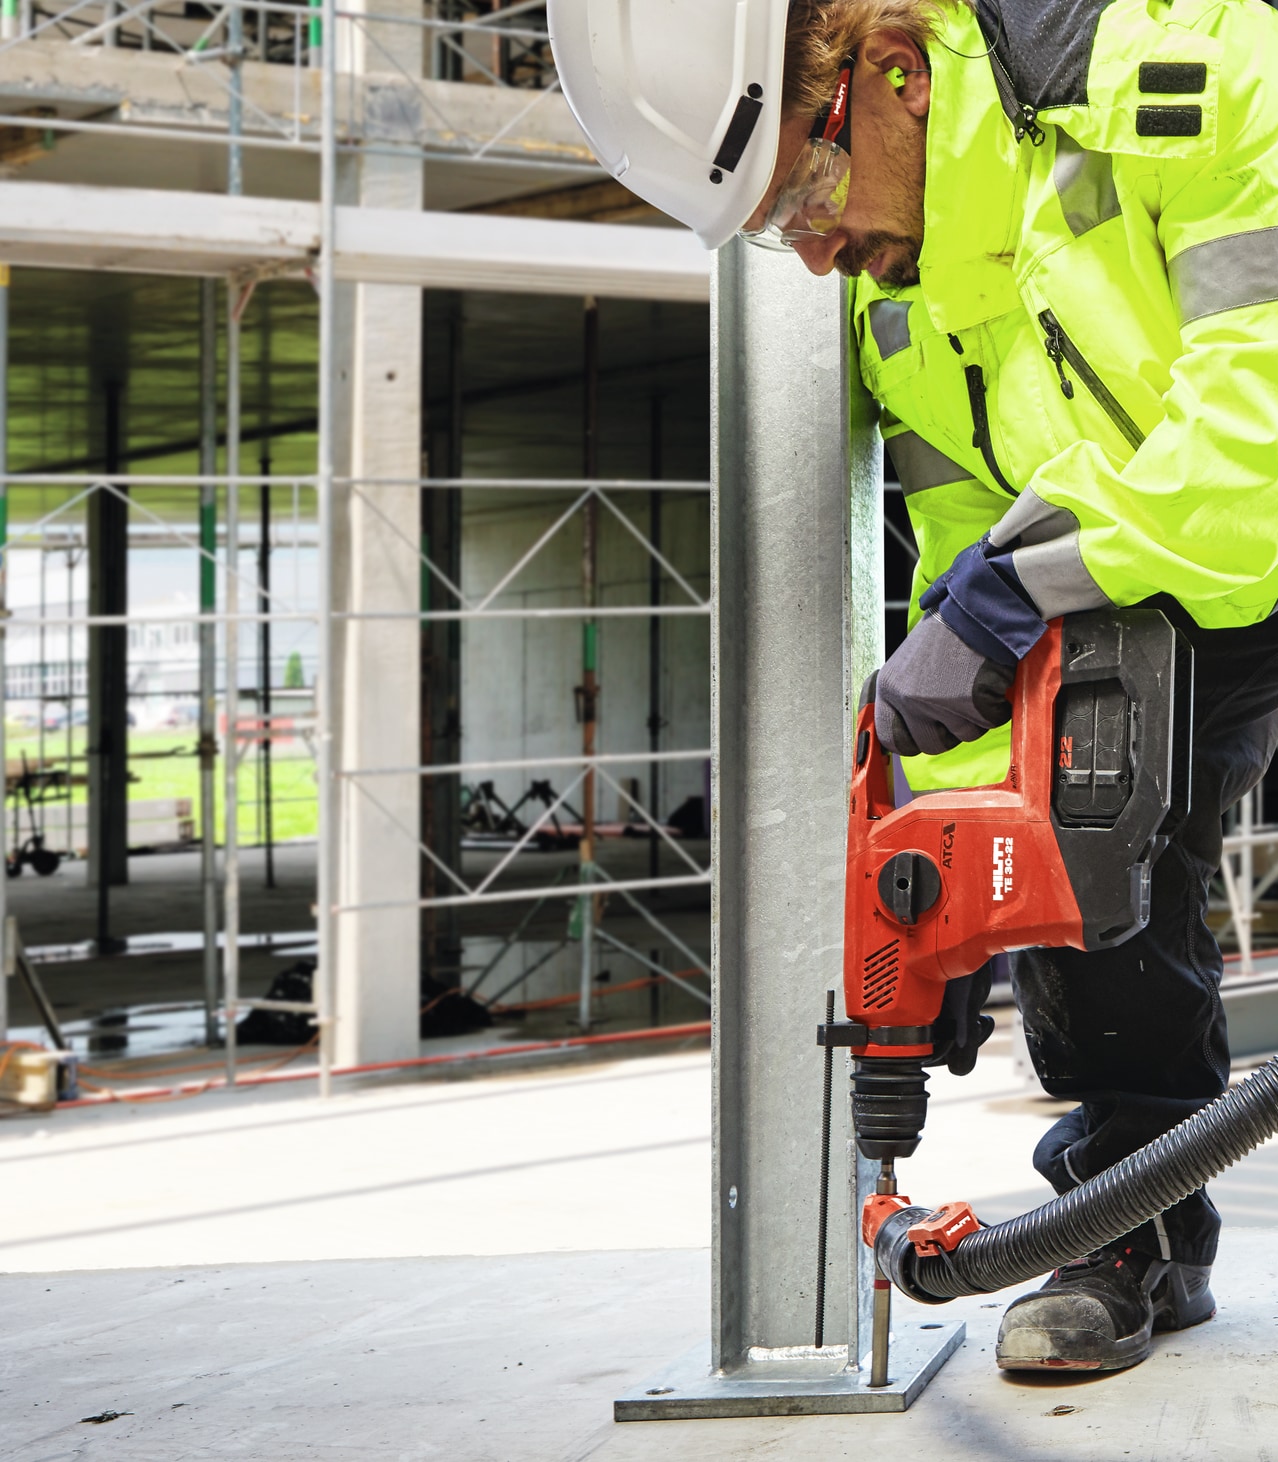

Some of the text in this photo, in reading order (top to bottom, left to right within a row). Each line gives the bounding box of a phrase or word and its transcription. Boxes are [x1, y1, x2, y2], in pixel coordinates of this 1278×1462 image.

[834, 83, 847, 115] HILTI
[1059, 736, 1073, 768] 22
[943, 833, 955, 869] ATC
[1004, 837, 1014, 893] TE 30-22
[993, 837, 1004, 901] HILTI
[946, 1215, 971, 1236] HILTI
